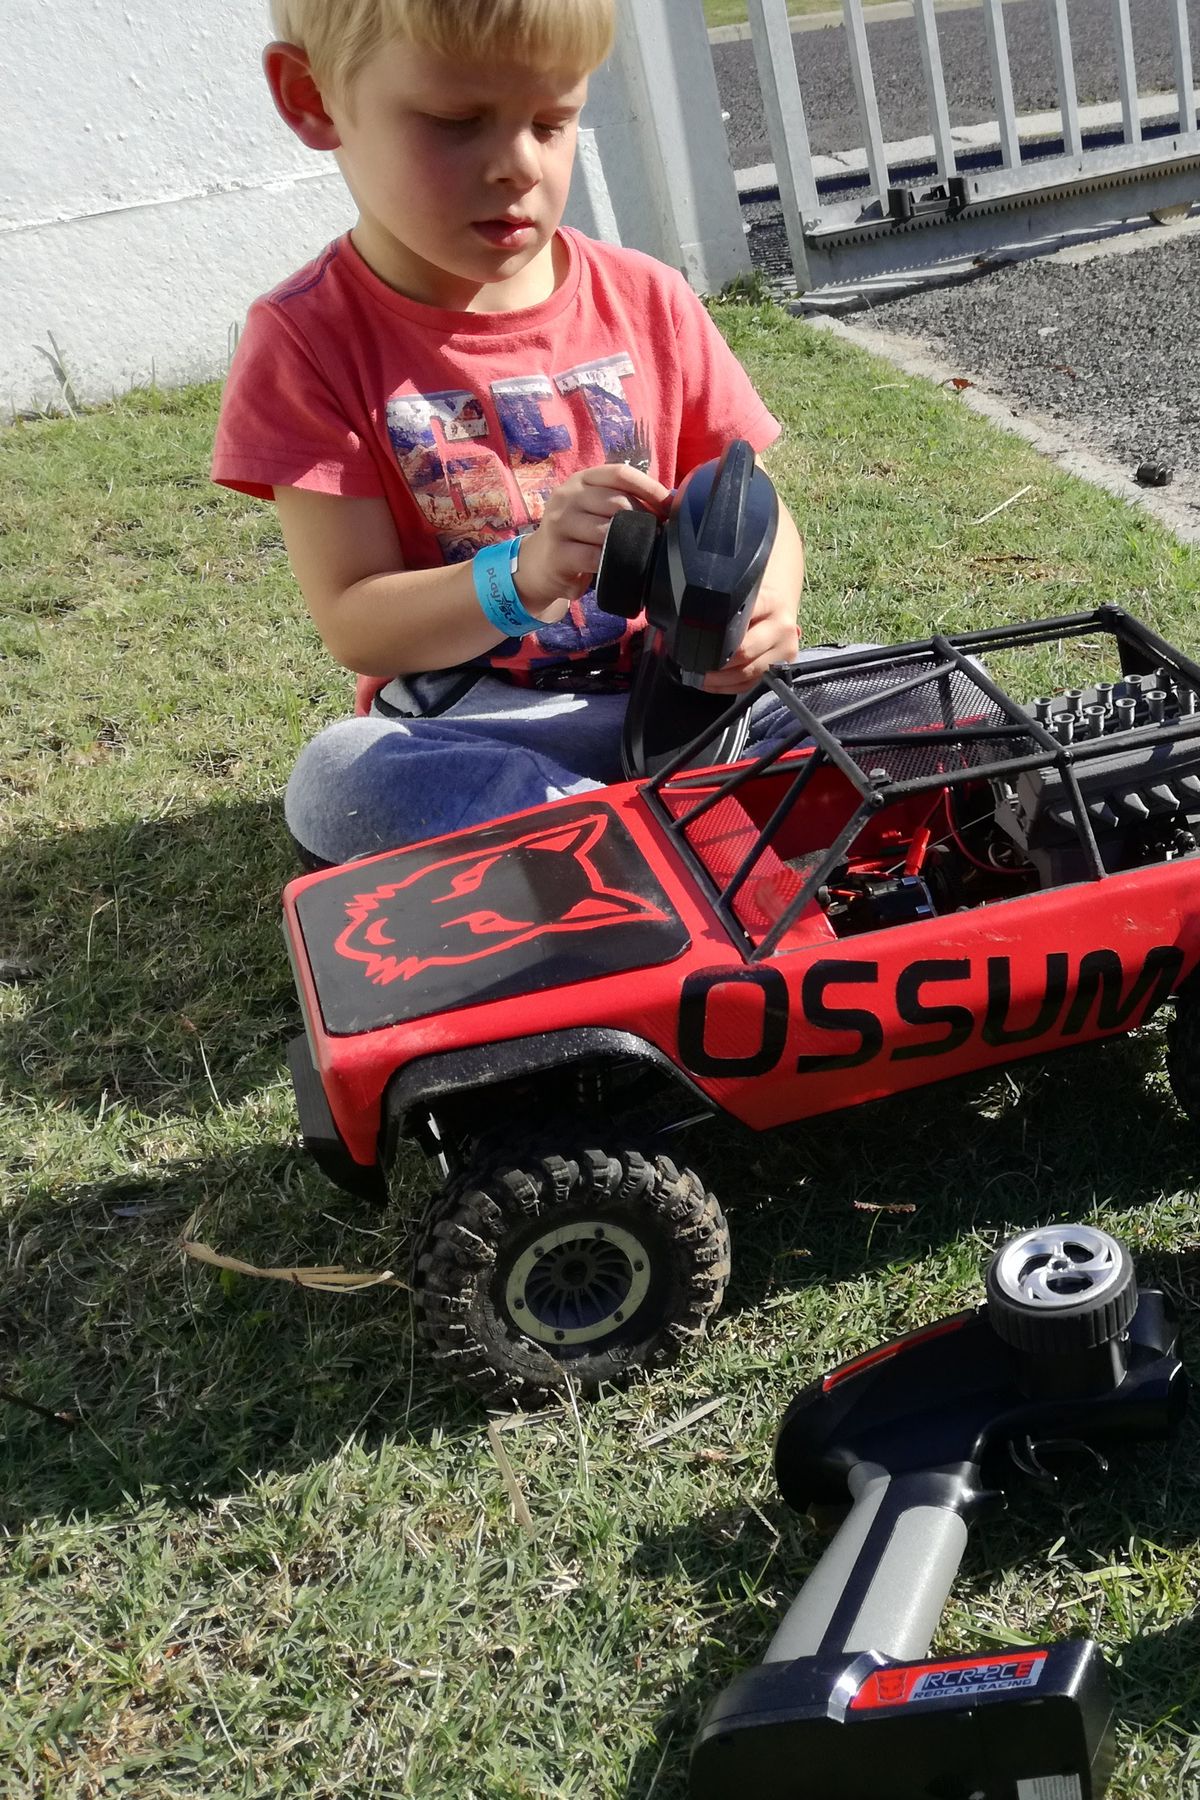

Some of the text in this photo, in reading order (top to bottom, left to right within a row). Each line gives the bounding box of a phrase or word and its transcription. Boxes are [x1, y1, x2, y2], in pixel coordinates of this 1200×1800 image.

[677, 945, 1185, 1078] OSSUM
[913, 1677, 1032, 1699] REDCAT RACING
[924, 1660, 1034, 1689] RCR-2CE
